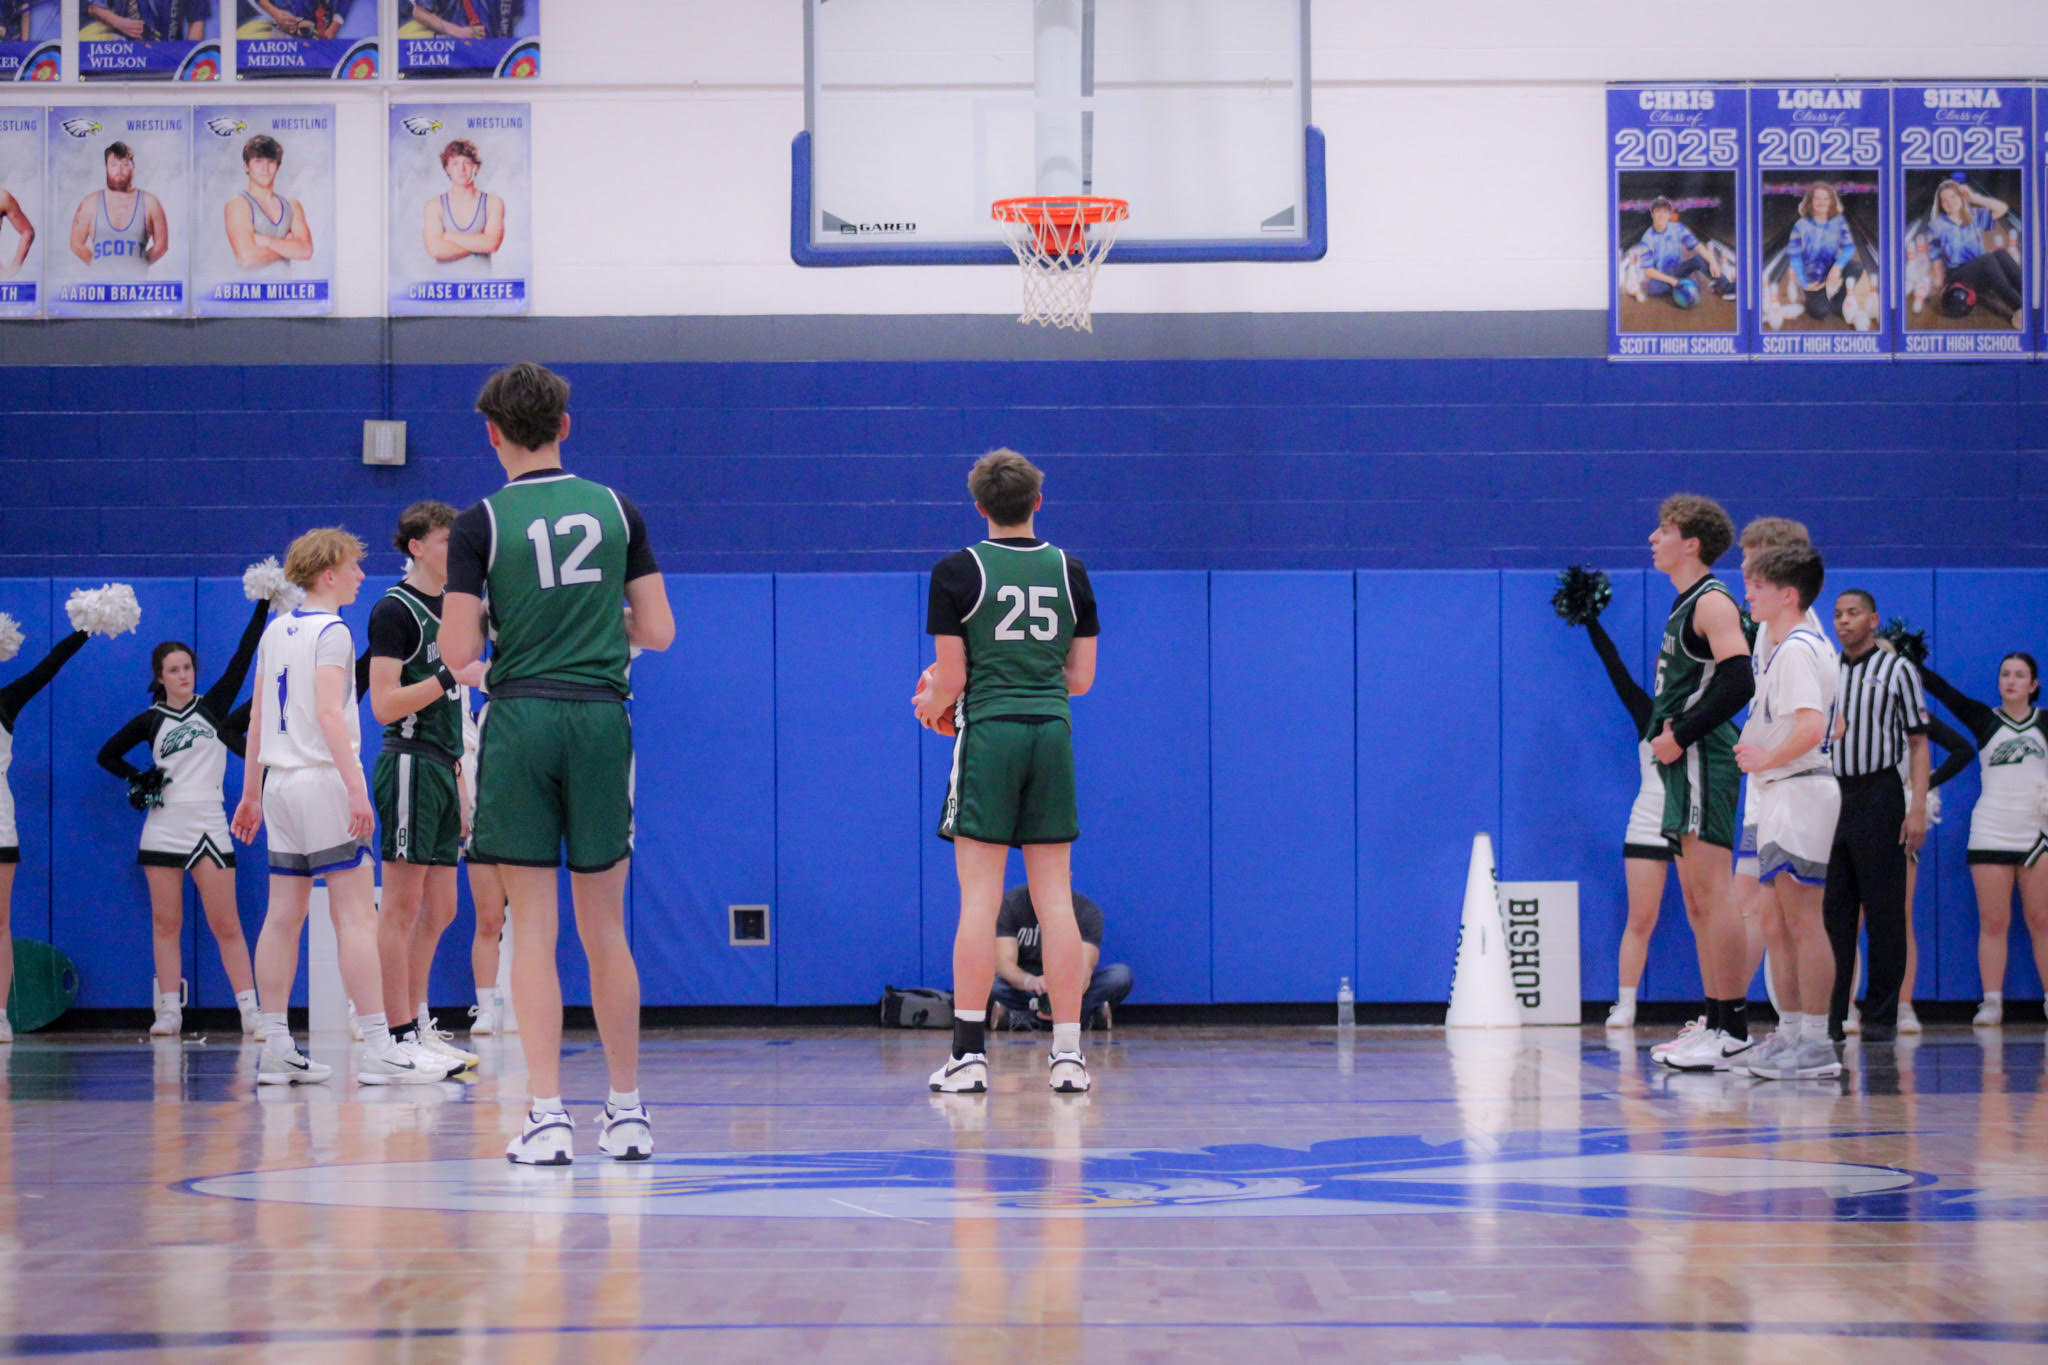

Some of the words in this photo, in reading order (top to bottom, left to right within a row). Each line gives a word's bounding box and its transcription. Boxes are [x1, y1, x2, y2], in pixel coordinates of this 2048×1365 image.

[88, 43, 133, 56] JASON
[247, 41, 297, 53] AARON
[407, 41, 455, 55] JAXON
[0, 57, 19, 68] ER
[90, 57, 147, 68] WILSON
[247, 55, 305, 66] MEDINA
[409, 54, 449, 66] ELAM
[1639, 90, 1714, 110] CHRIS
[1777, 89, 1861, 109] LOGAN
[1923, 88, 2001, 109] SIENA
[126, 120, 182, 131] WRESTLING
[272, 118, 327, 130] WRESTLING
[467, 117, 523, 129] WRESTLING
[1649, 110, 1685, 122] Class
[1686, 112, 1702, 127] of
[1792, 110, 1827, 121] Class
[1829, 111, 1846, 127] of
[1935, 109, 1970, 121] Class
[1972, 110, 1989, 126] of
[1615, 128, 1738, 166] 2025
[1758, 127, 1881, 166] 2025
[1901, 127, 2024, 165] 2025
[860, 223, 916, 231] GARED
[94, 240, 145, 259] SCOTT
[61, 286, 105, 300] AARON
[111, 285, 177, 300] BRAZZELL
[214, 284, 260, 299] ABRAM
[266, 284, 315, 299] MILLER
[409, 284, 452, 298] CHASE
[458, 284, 512, 298] O'KEEFE
[1620, 338, 1657, 353] SCOTT
[1660, 338, 1687, 353] HIGH
[1690, 337, 1736, 353] SCHOOL
[1763, 336, 1800, 352] SCOTT
[1803, 336, 1831, 352] HIGH
[1834, 336, 1879, 352] SCHOOL
[1906, 335, 1943, 351] SCOTT
[1946, 335, 1974, 351] HIGH
[1977, 335, 2022, 351] SCHOOL
[526, 513, 603, 589] 12
[995, 585, 1058, 641] 25
[276, 665, 289, 734] 1
[398, 828, 406, 847] B
[1509, 898, 1541, 1008] BISHOP
